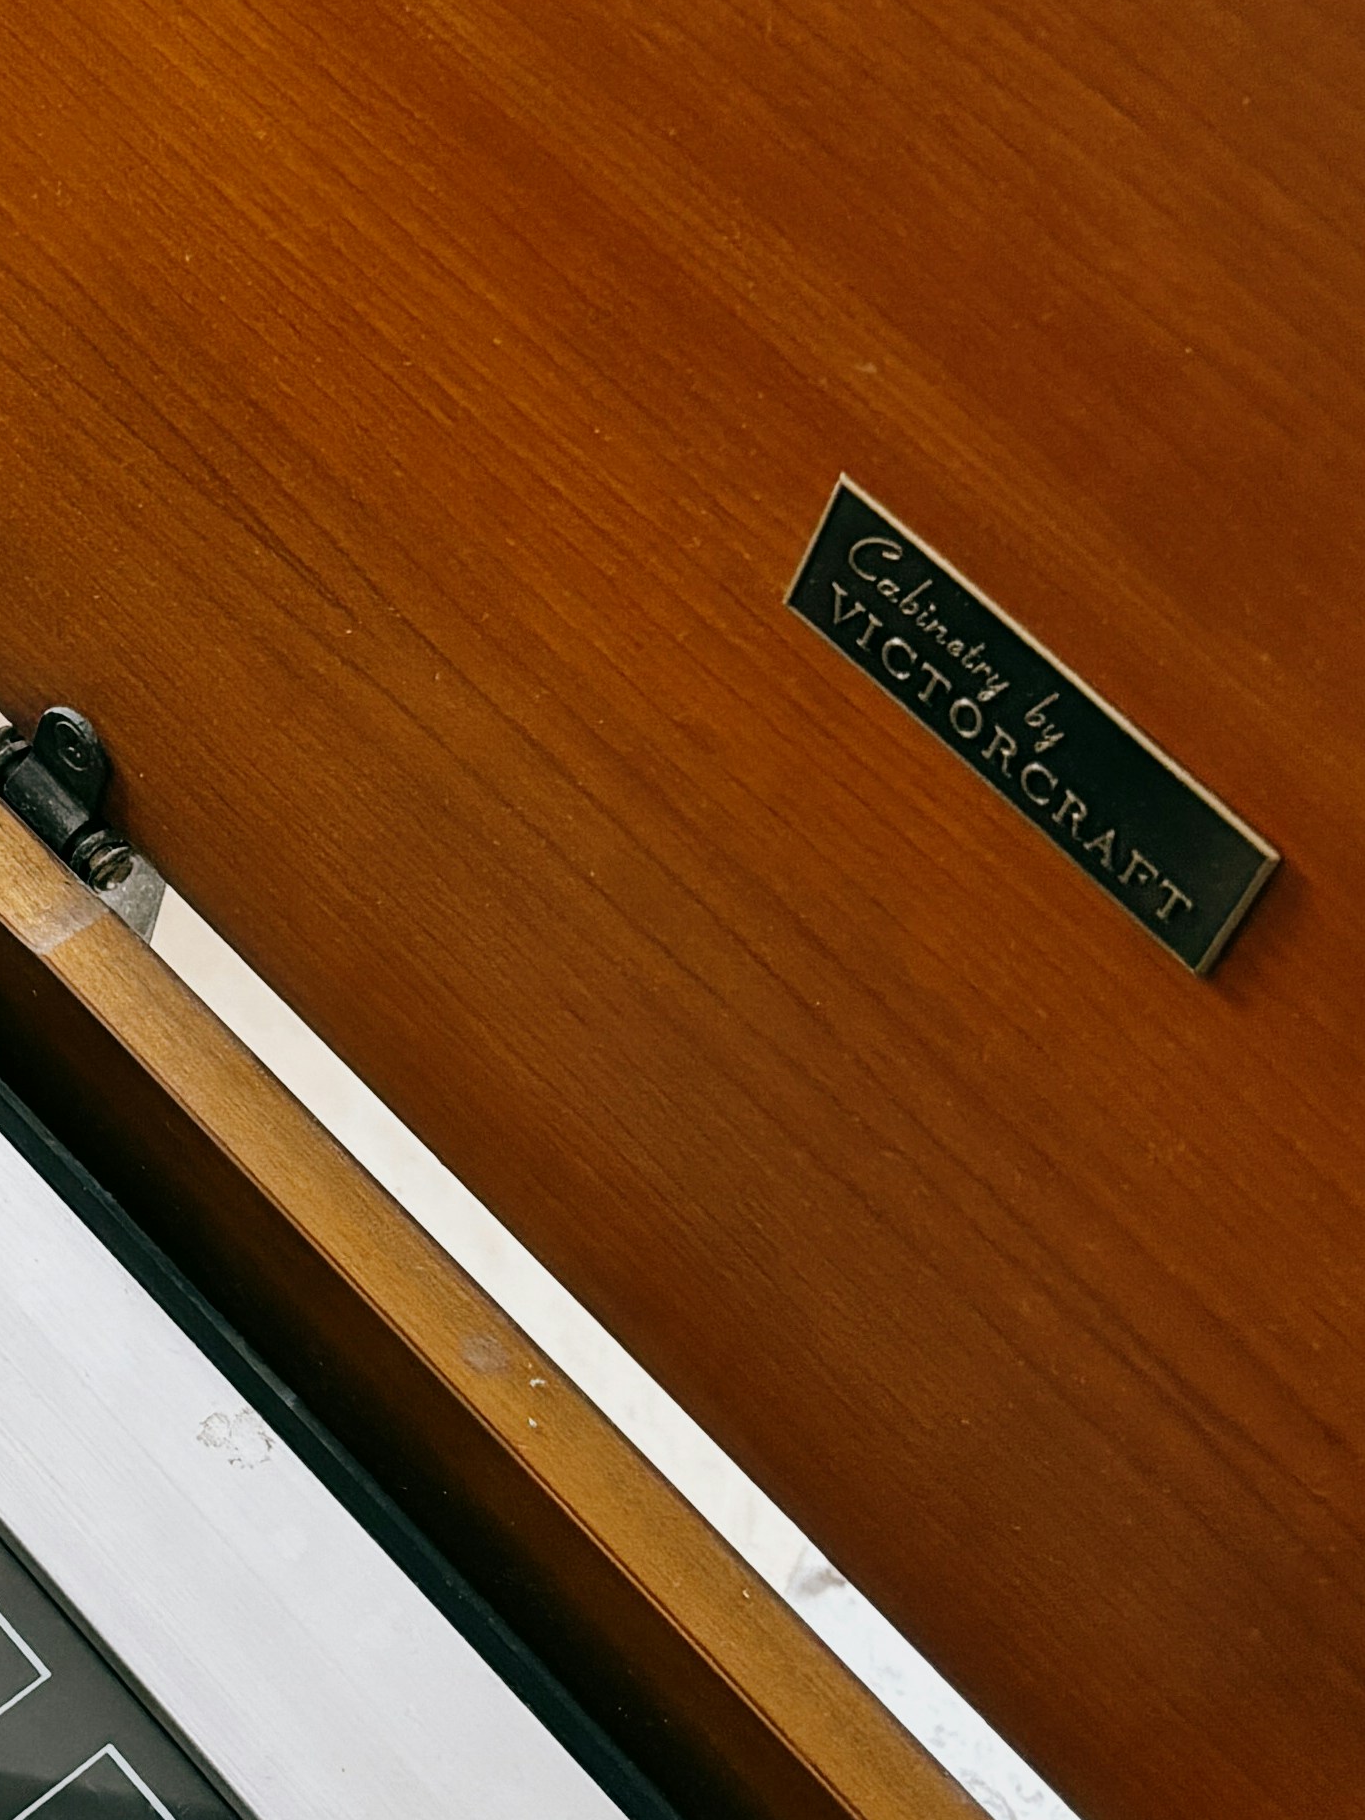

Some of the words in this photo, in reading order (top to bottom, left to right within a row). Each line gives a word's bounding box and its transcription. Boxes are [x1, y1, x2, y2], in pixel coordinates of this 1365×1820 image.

[830, 580, 1193, 919] VICTORCRAFT
[848, 535, 1010, 702] Cabinetry
[1024, 691, 1065, 753] by
